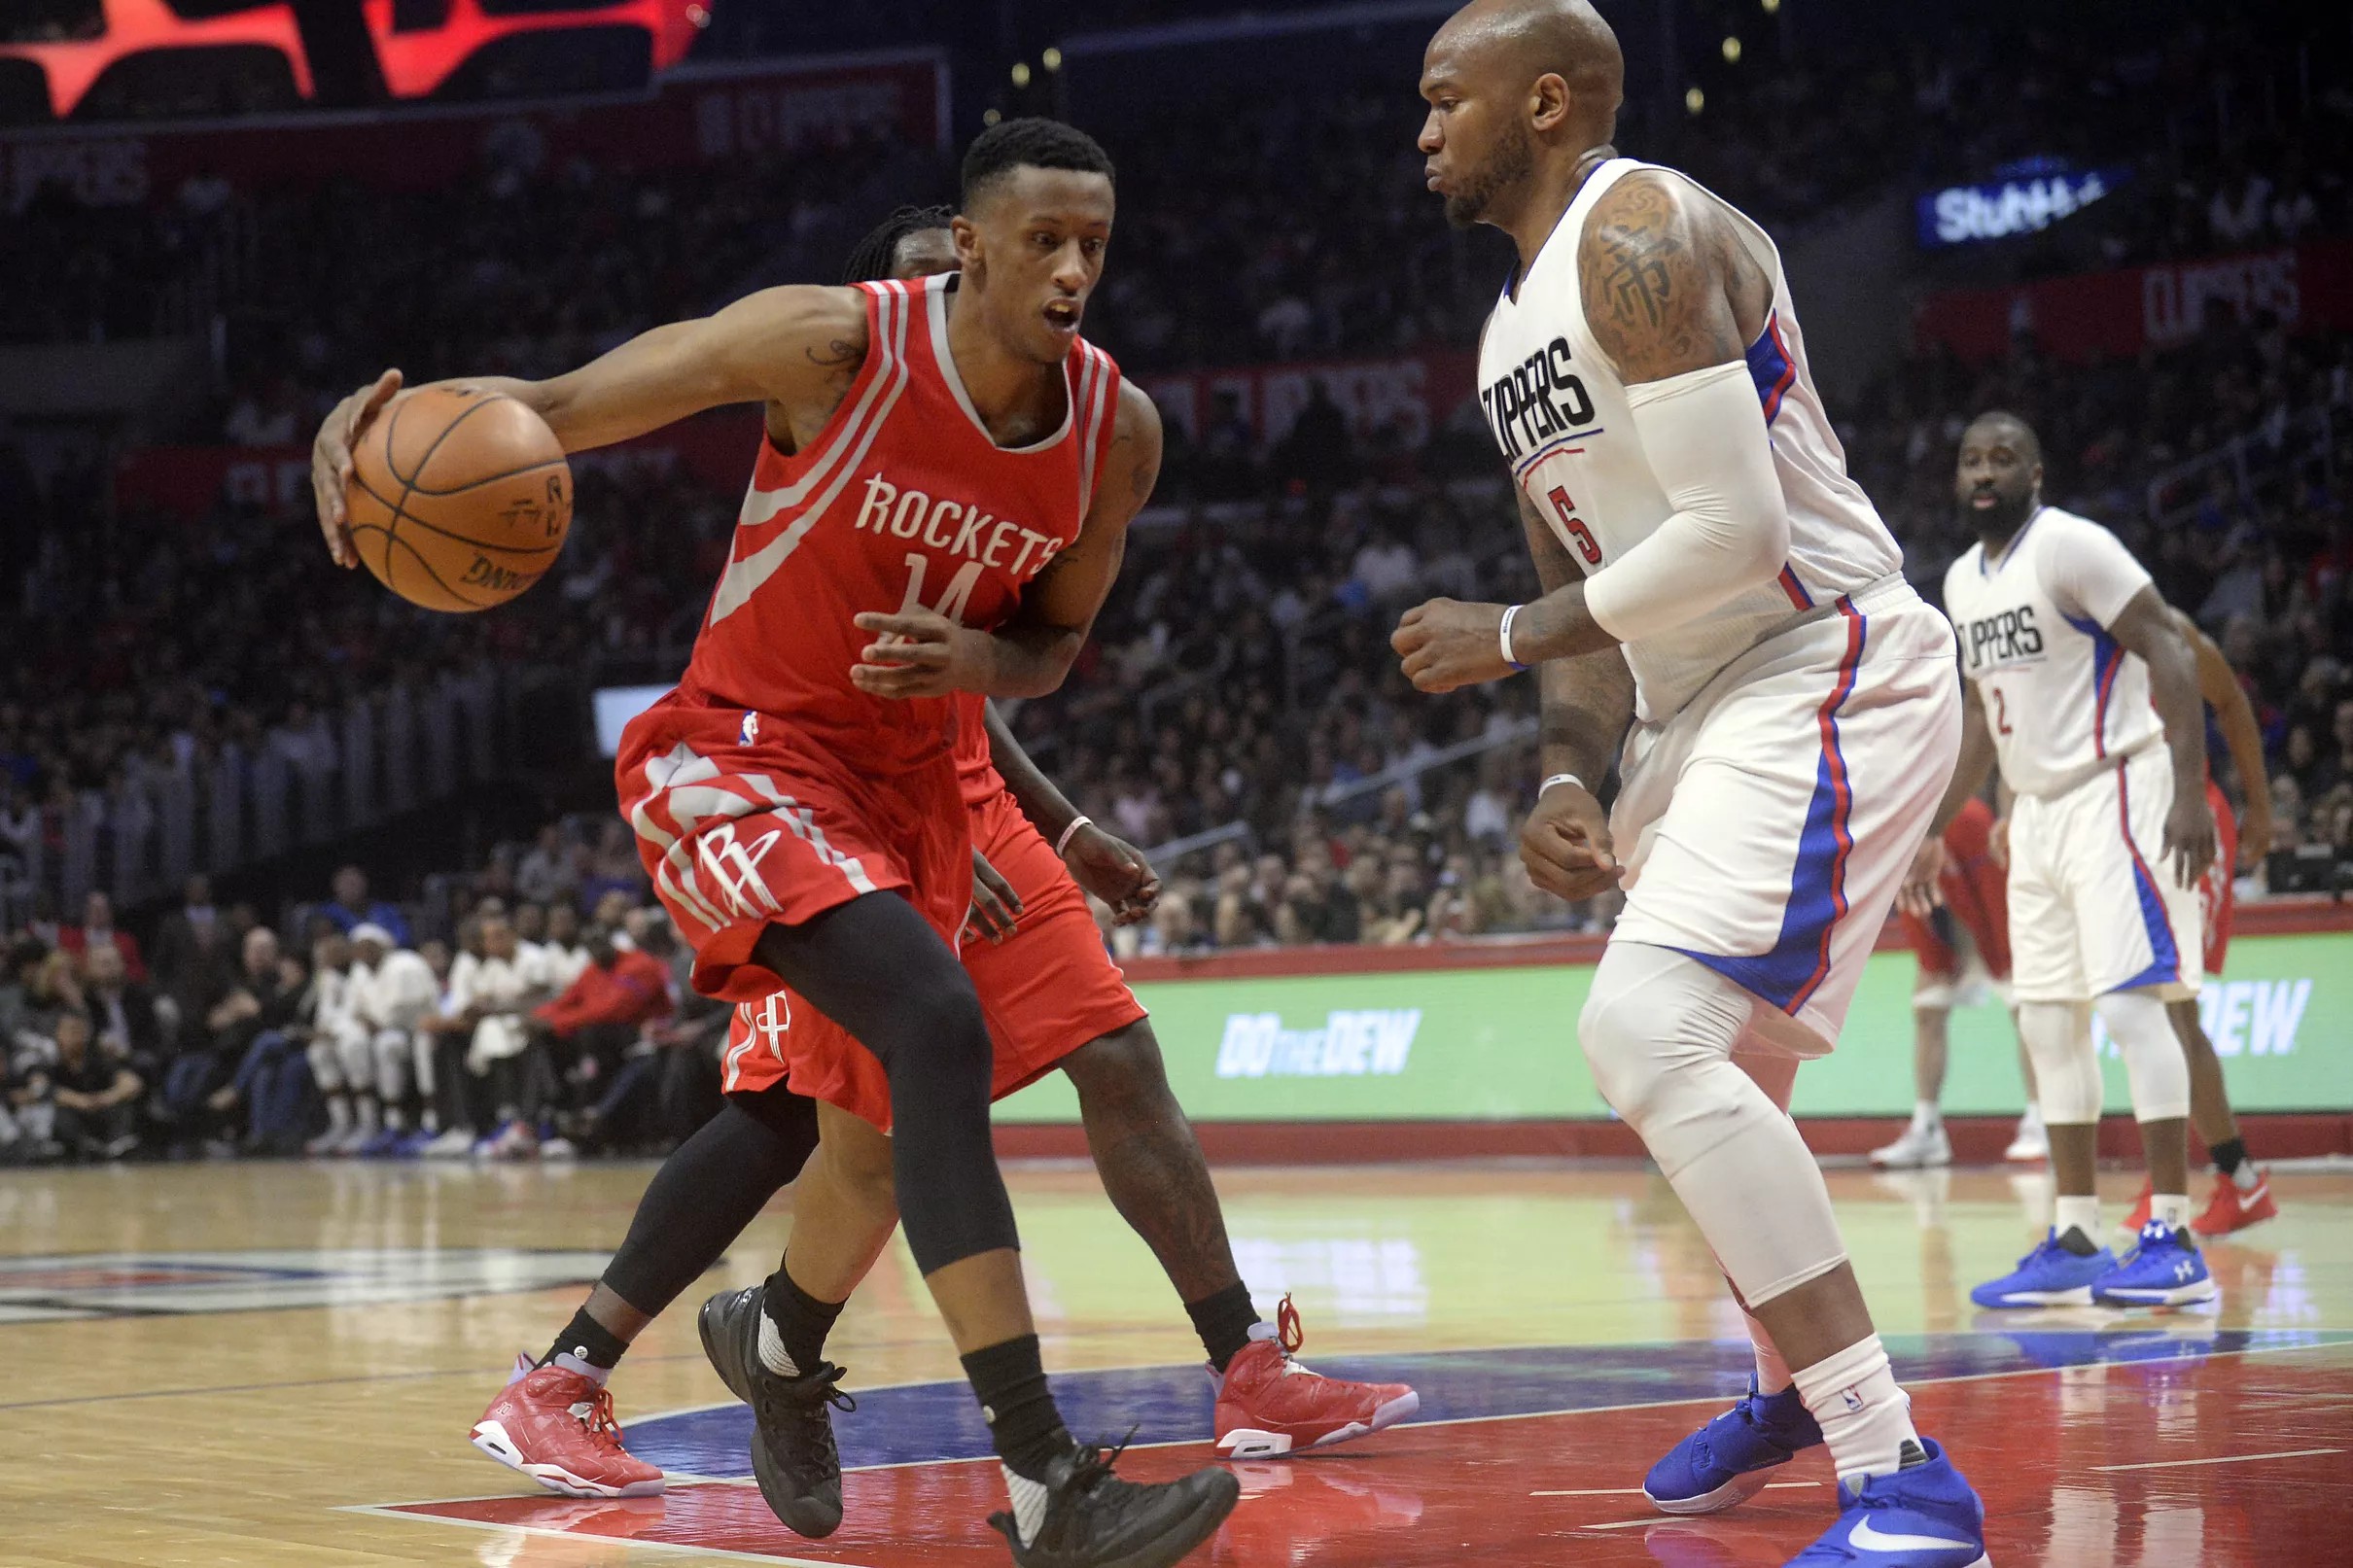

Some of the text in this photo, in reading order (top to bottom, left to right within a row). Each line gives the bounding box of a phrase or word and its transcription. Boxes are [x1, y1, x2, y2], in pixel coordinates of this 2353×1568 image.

[1482, 335, 1595, 467] LIPPERS
[855, 471, 1064, 575] ROCKETS
[1547, 485, 1602, 566] 5
[904, 552, 985, 625] 14
[1957, 605, 2044, 669] LIPPERS
[1994, 687, 2013, 735] 2
